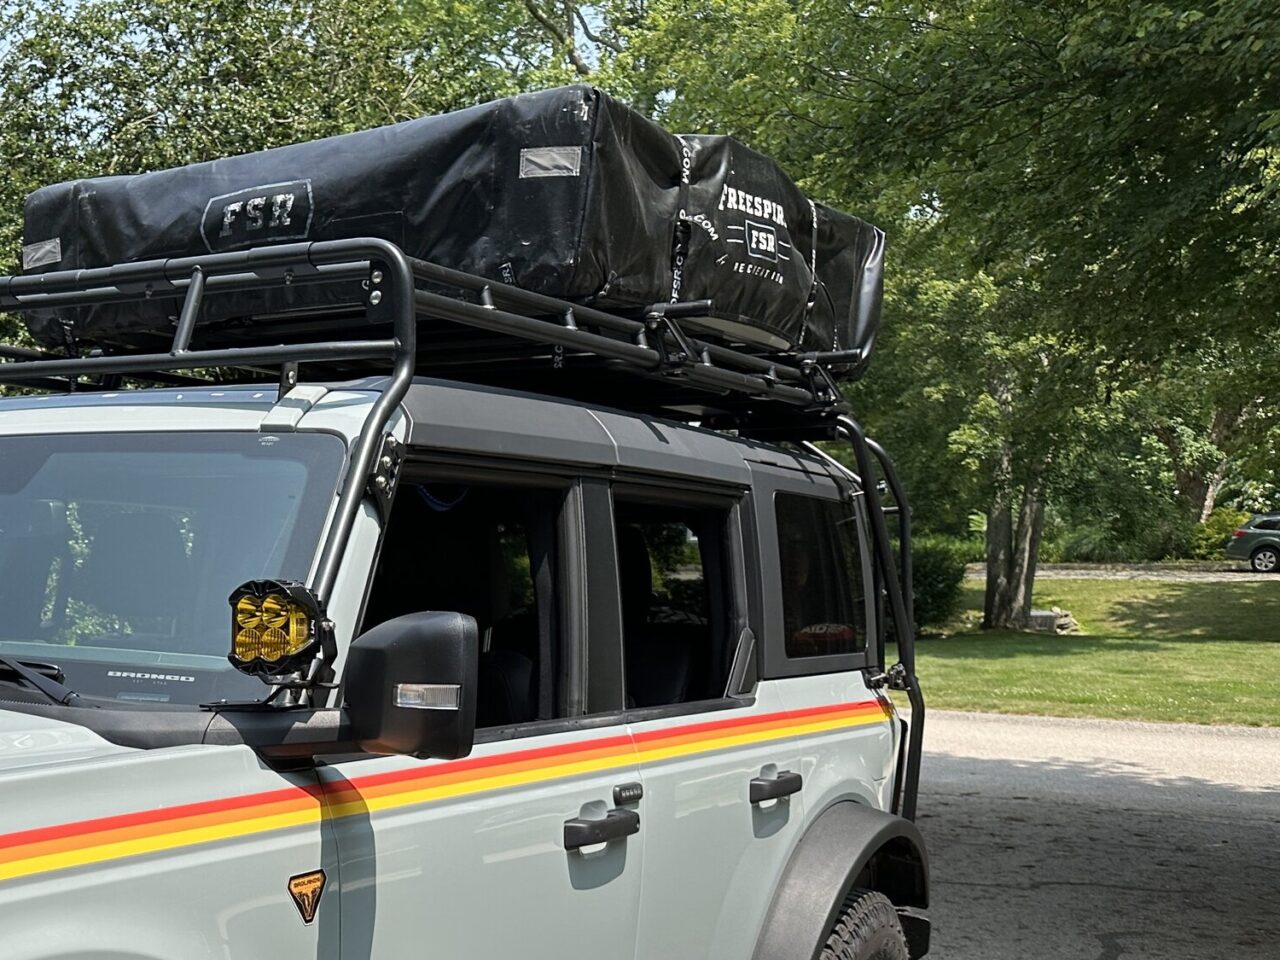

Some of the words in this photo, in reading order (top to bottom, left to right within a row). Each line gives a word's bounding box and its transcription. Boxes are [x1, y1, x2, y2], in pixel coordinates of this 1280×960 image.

[219, 193, 295, 238] FSR
[718, 183, 788, 229] FREESPIR
[750, 229, 777, 253] FSR
[106, 670, 196, 683] BRONCO
